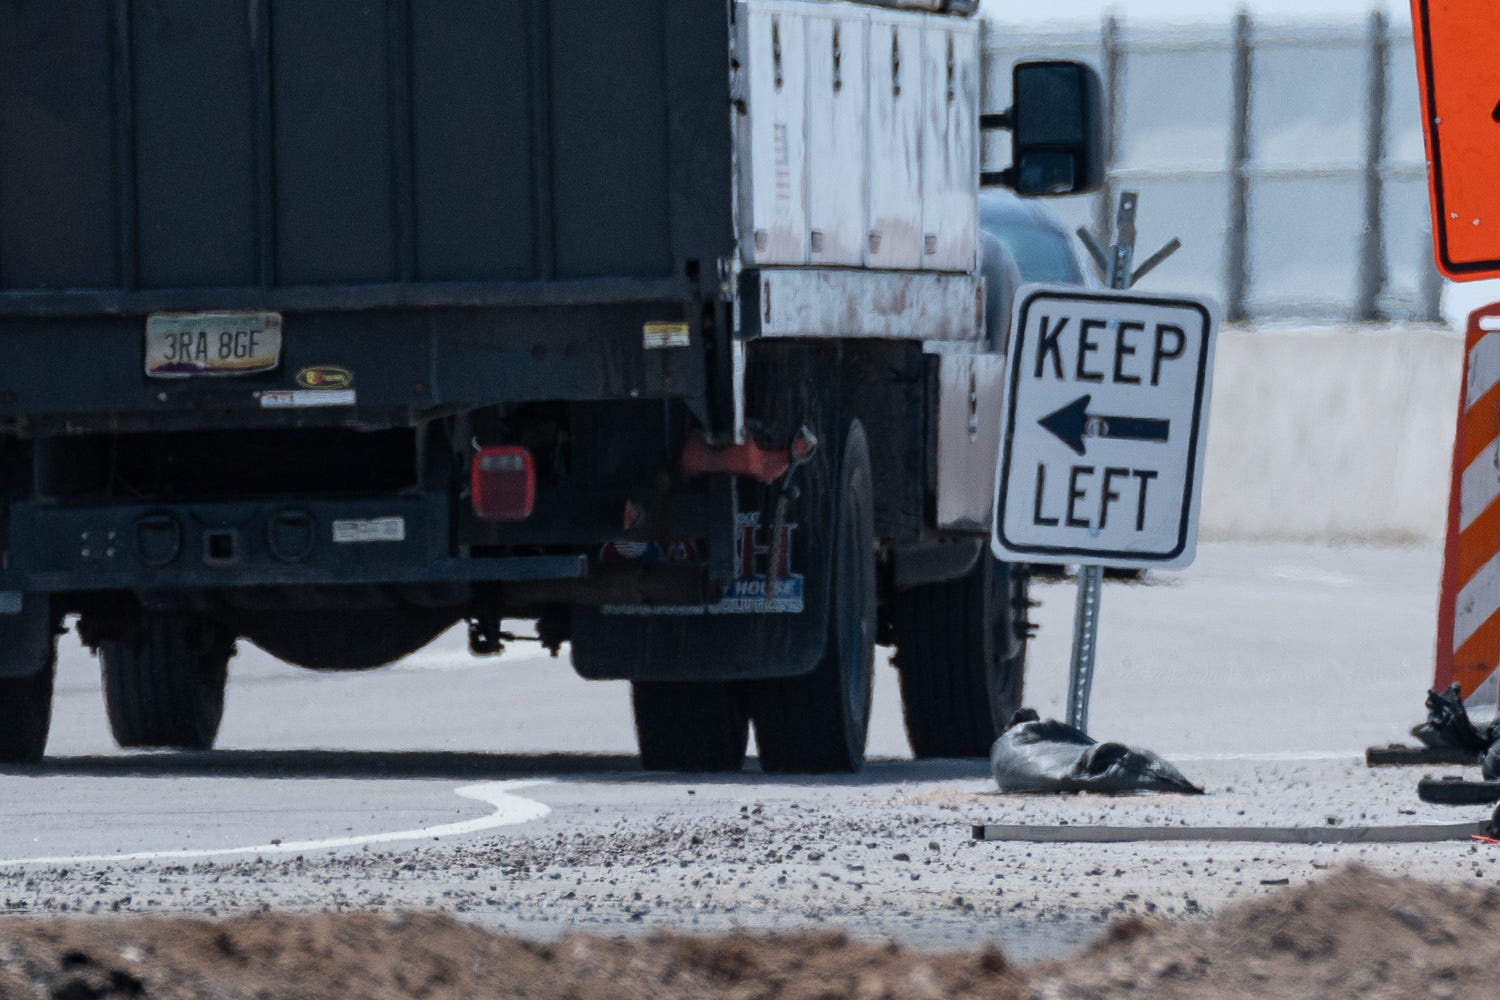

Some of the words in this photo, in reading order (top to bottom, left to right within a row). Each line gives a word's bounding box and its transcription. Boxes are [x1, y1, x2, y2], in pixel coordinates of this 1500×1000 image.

[163, 331, 208, 361] 3RA
[218, 329, 264, 359] 8GF
[1033, 316, 1187, 387] KEEP
[1032, 463, 1158, 532] LEFT
